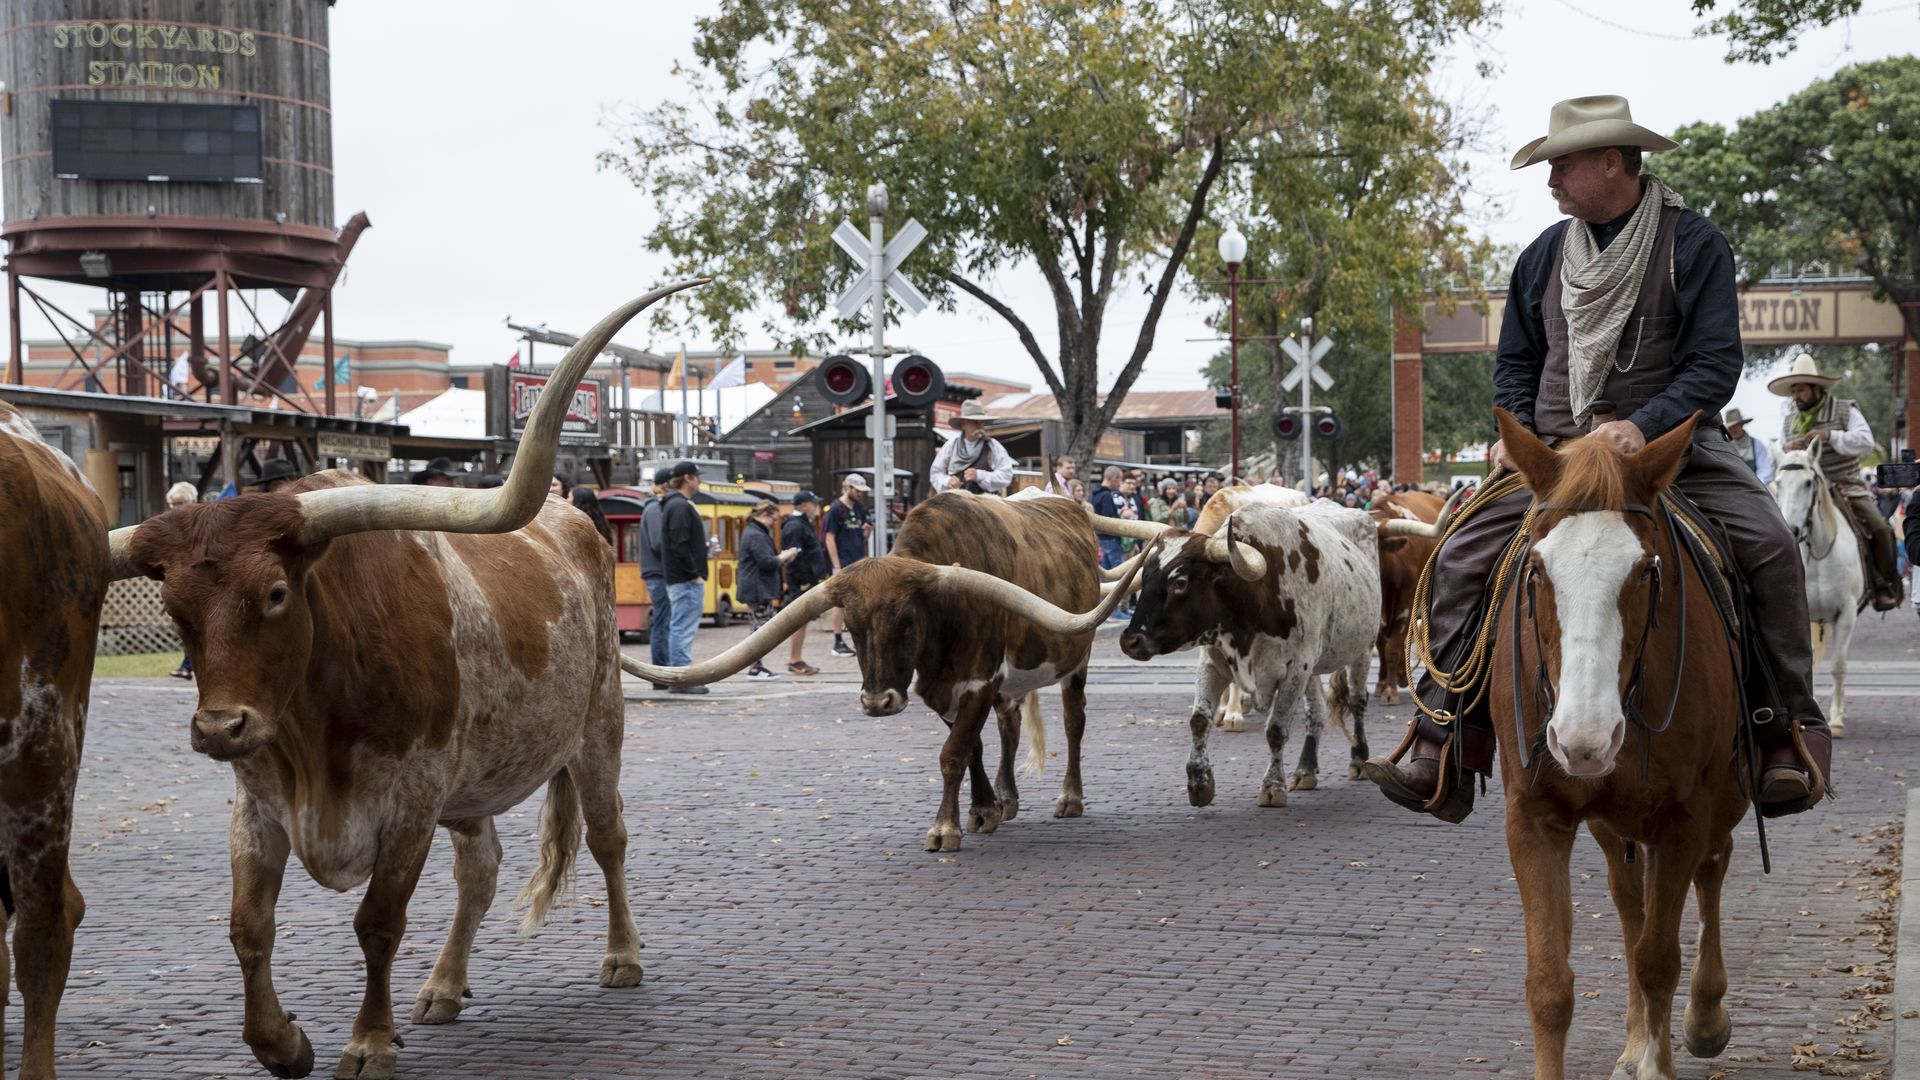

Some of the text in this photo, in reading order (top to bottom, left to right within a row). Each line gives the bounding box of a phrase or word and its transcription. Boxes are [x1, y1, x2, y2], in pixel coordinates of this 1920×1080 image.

[54, 22, 256, 56] STOCKYARDS
[88, 61, 220, 89] STATION
[1739, 298, 1821, 331] ATION
